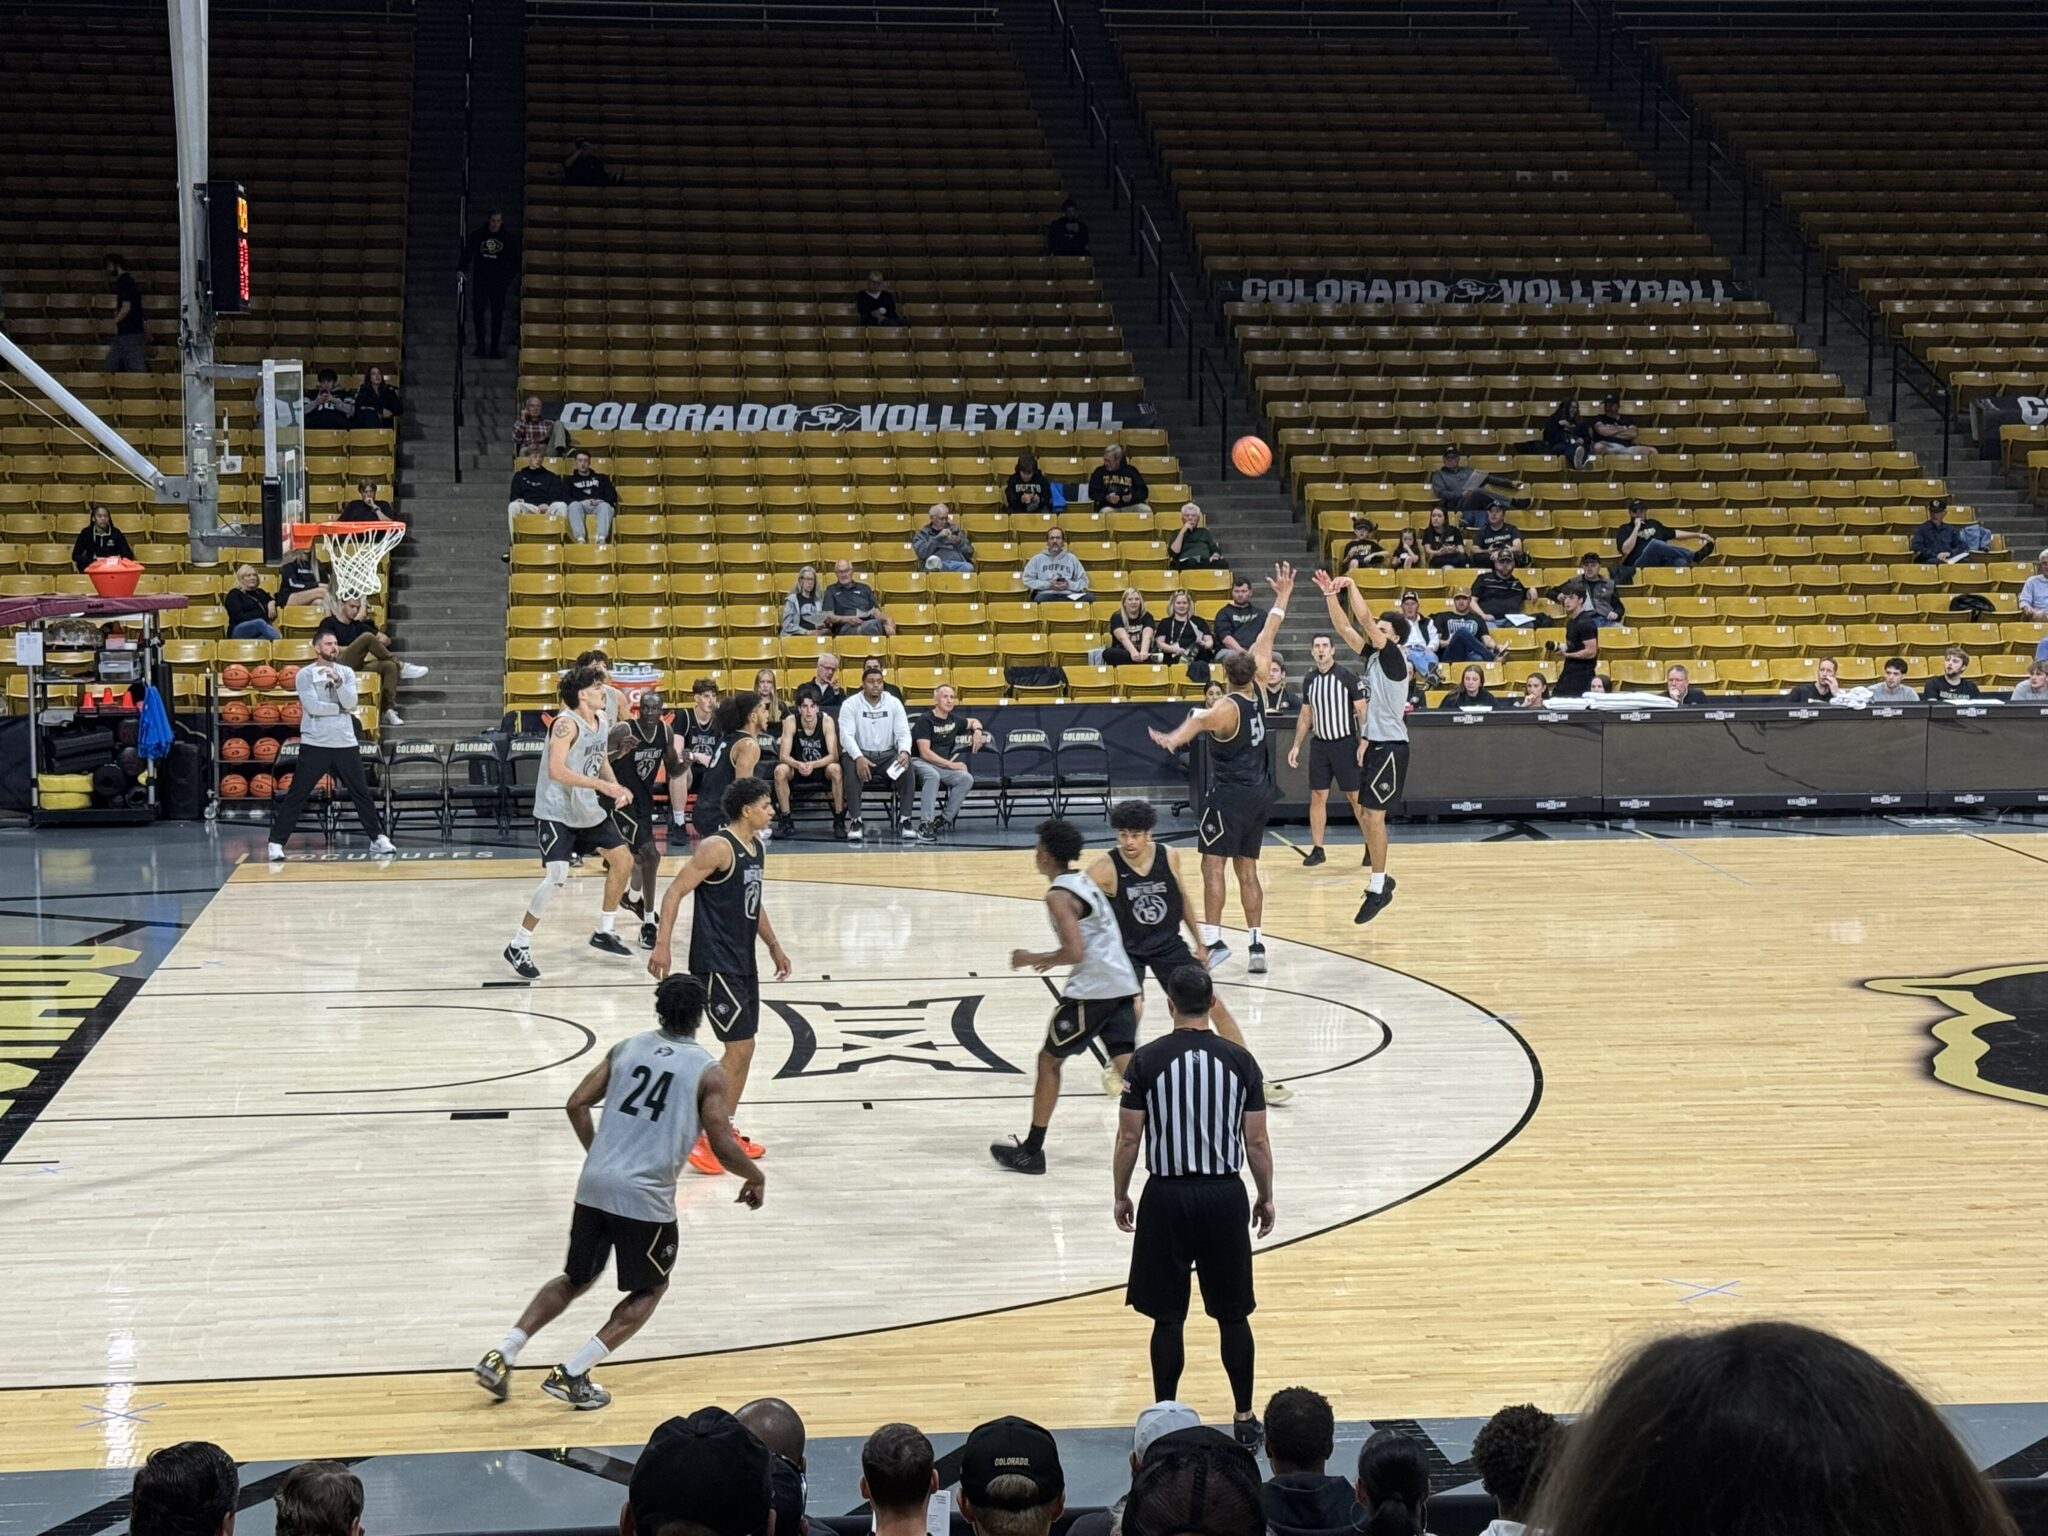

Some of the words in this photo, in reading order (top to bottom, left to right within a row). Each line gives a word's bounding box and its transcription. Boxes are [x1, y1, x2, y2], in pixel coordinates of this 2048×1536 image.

[1242, 278, 1449, 303] COLORADO
[1499, 279, 1733, 303] VOLLEYBALL
[560, 402, 798, 431] COLORADO
[860, 402, 1123, 431] VOLLEYBALL
[1043, 564, 1071, 574] BUFFS
[629, 689, 641, 701] G
[1009, 733, 1046, 743] COLORADO
[1062, 732, 1100, 742] COLORADO
[396, 744, 435, 754] COLORADO
[454, 743, 493, 752] COLORADO
[511, 741, 545, 751] COLORAD
[592, 764, 599, 777] 3
[619, 1065, 675, 1122] 24
[994, 1457, 1030, 1467] COLORADO
